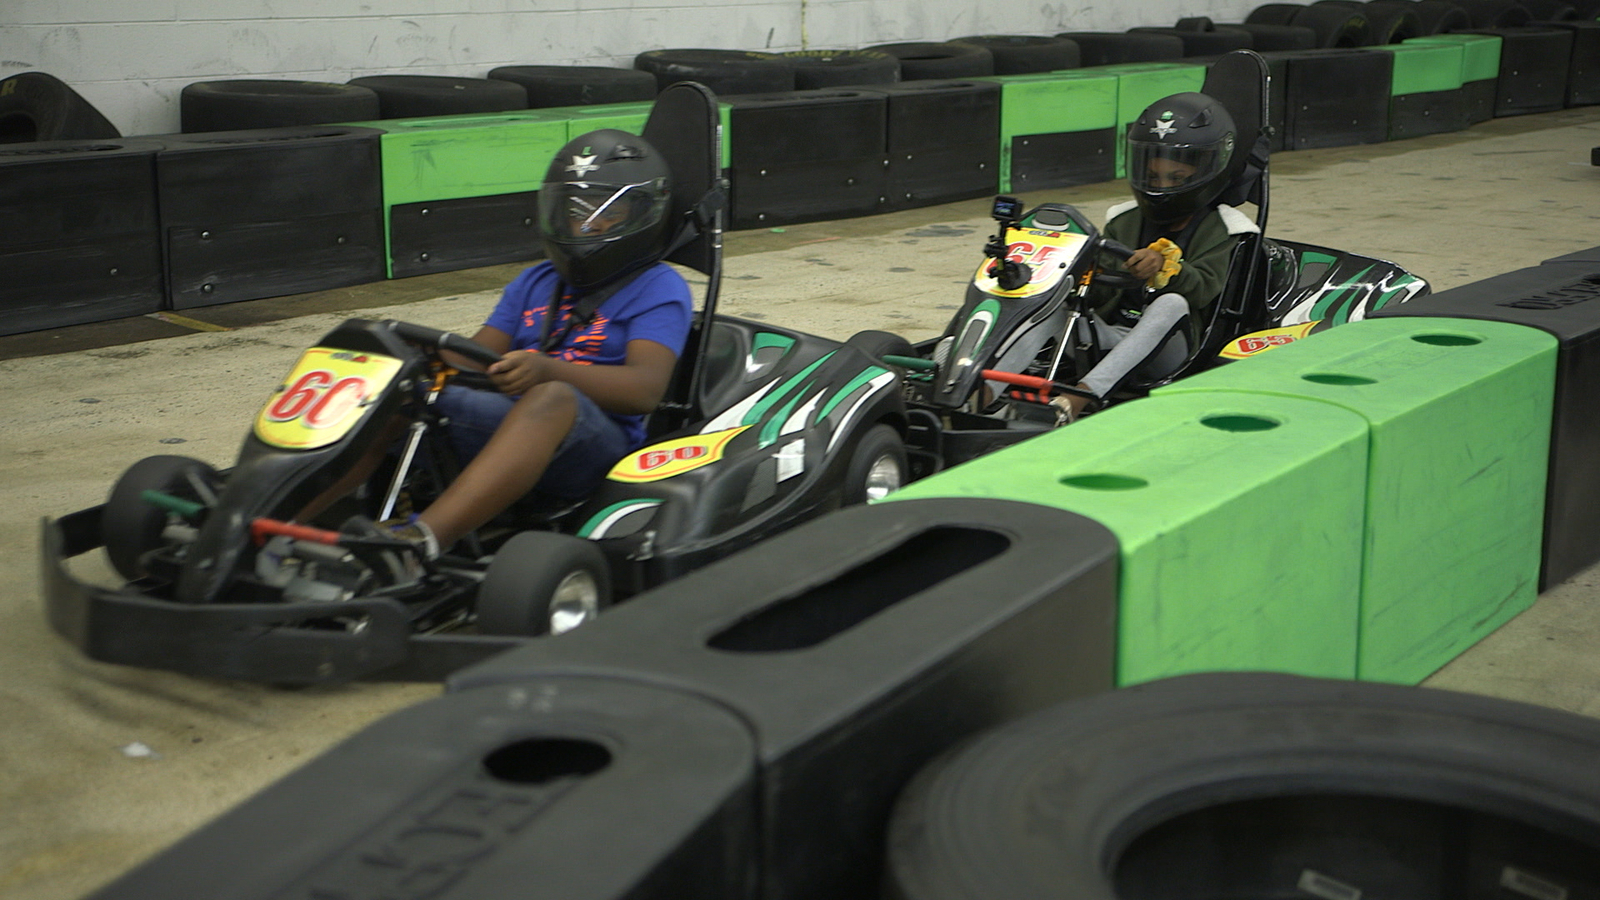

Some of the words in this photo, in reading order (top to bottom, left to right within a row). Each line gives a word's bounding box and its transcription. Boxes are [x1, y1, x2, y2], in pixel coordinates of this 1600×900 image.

[986, 241, 1064, 284] 65
[1237, 334, 1298, 354] 65
[268, 370, 368, 429] 60
[637, 445, 708, 472] 60
